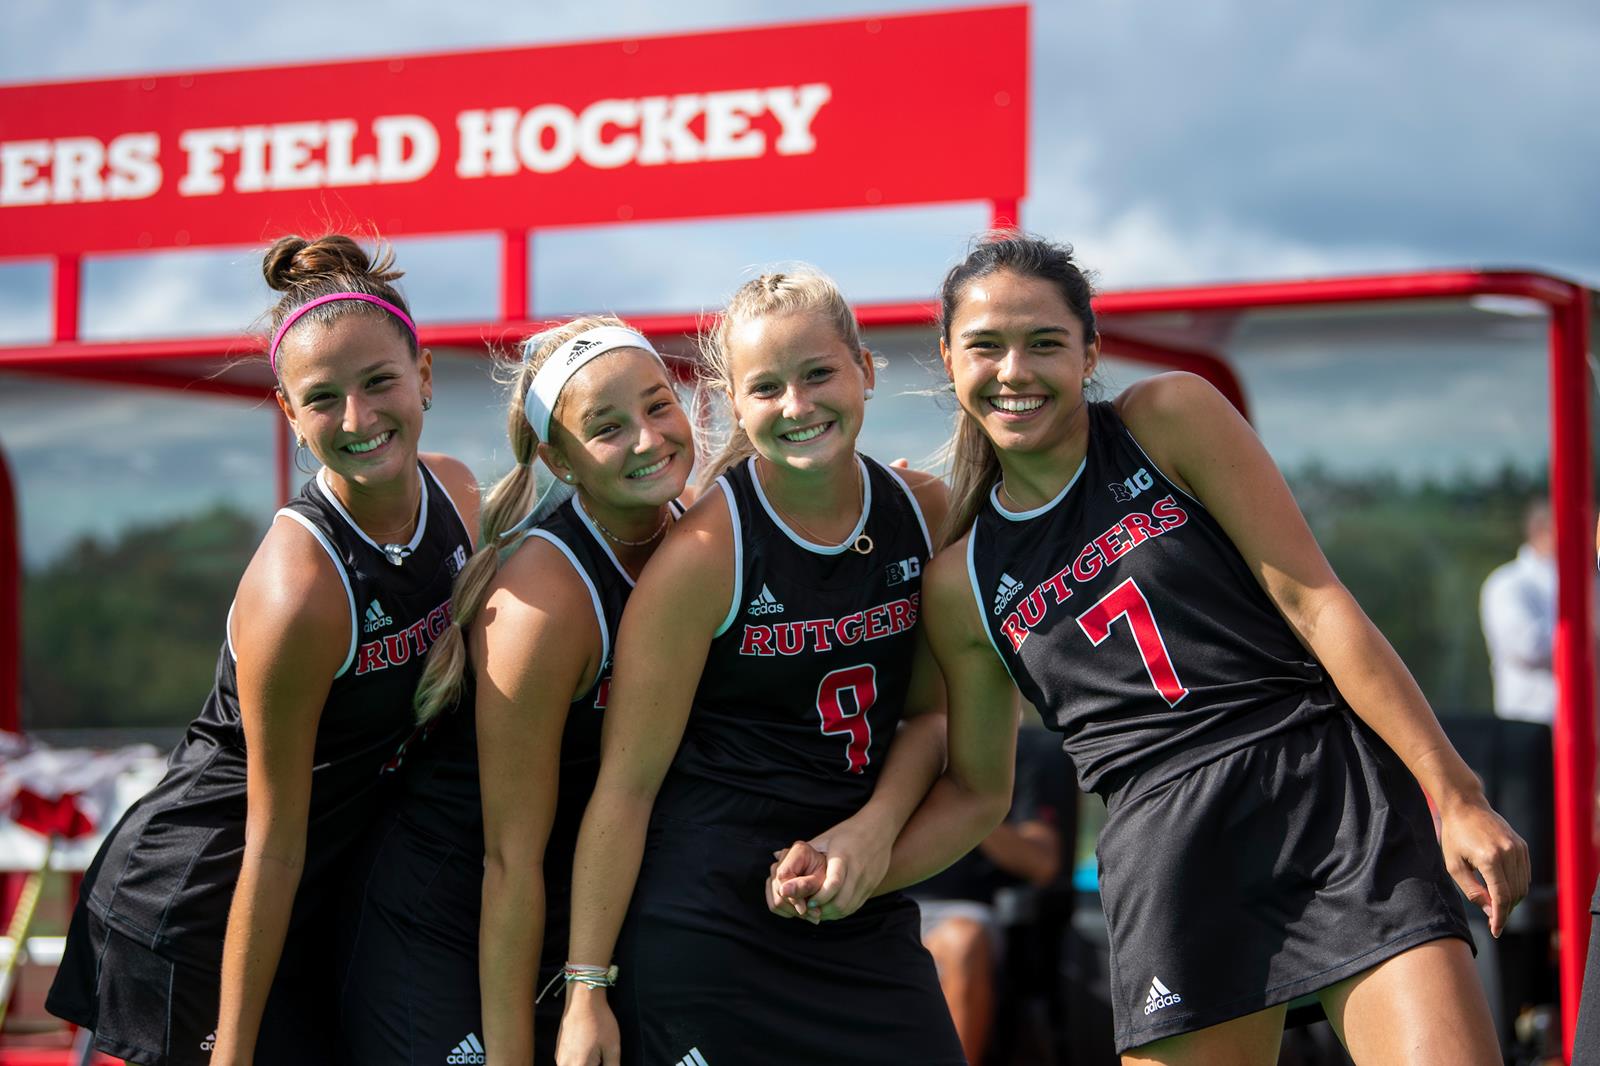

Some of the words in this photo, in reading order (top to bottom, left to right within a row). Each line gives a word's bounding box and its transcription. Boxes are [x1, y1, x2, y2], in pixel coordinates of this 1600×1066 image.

[178, 114, 440, 197] FIELD
[456, 82, 831, 179] HOCKEY
[566, 340, 603, 366] adidas
[994, 580, 1024, 616] adidas
[1000, 494, 1188, 655] RUTGERS
[739, 592, 920, 657] RUTGERS
[748, 602, 785, 617] addas
[1075, 576, 1190, 709] 7
[816, 663, 878, 774] 9
[1144, 993, 1181, 1015] adidas
[446, 1052, 486, 1065] adida
